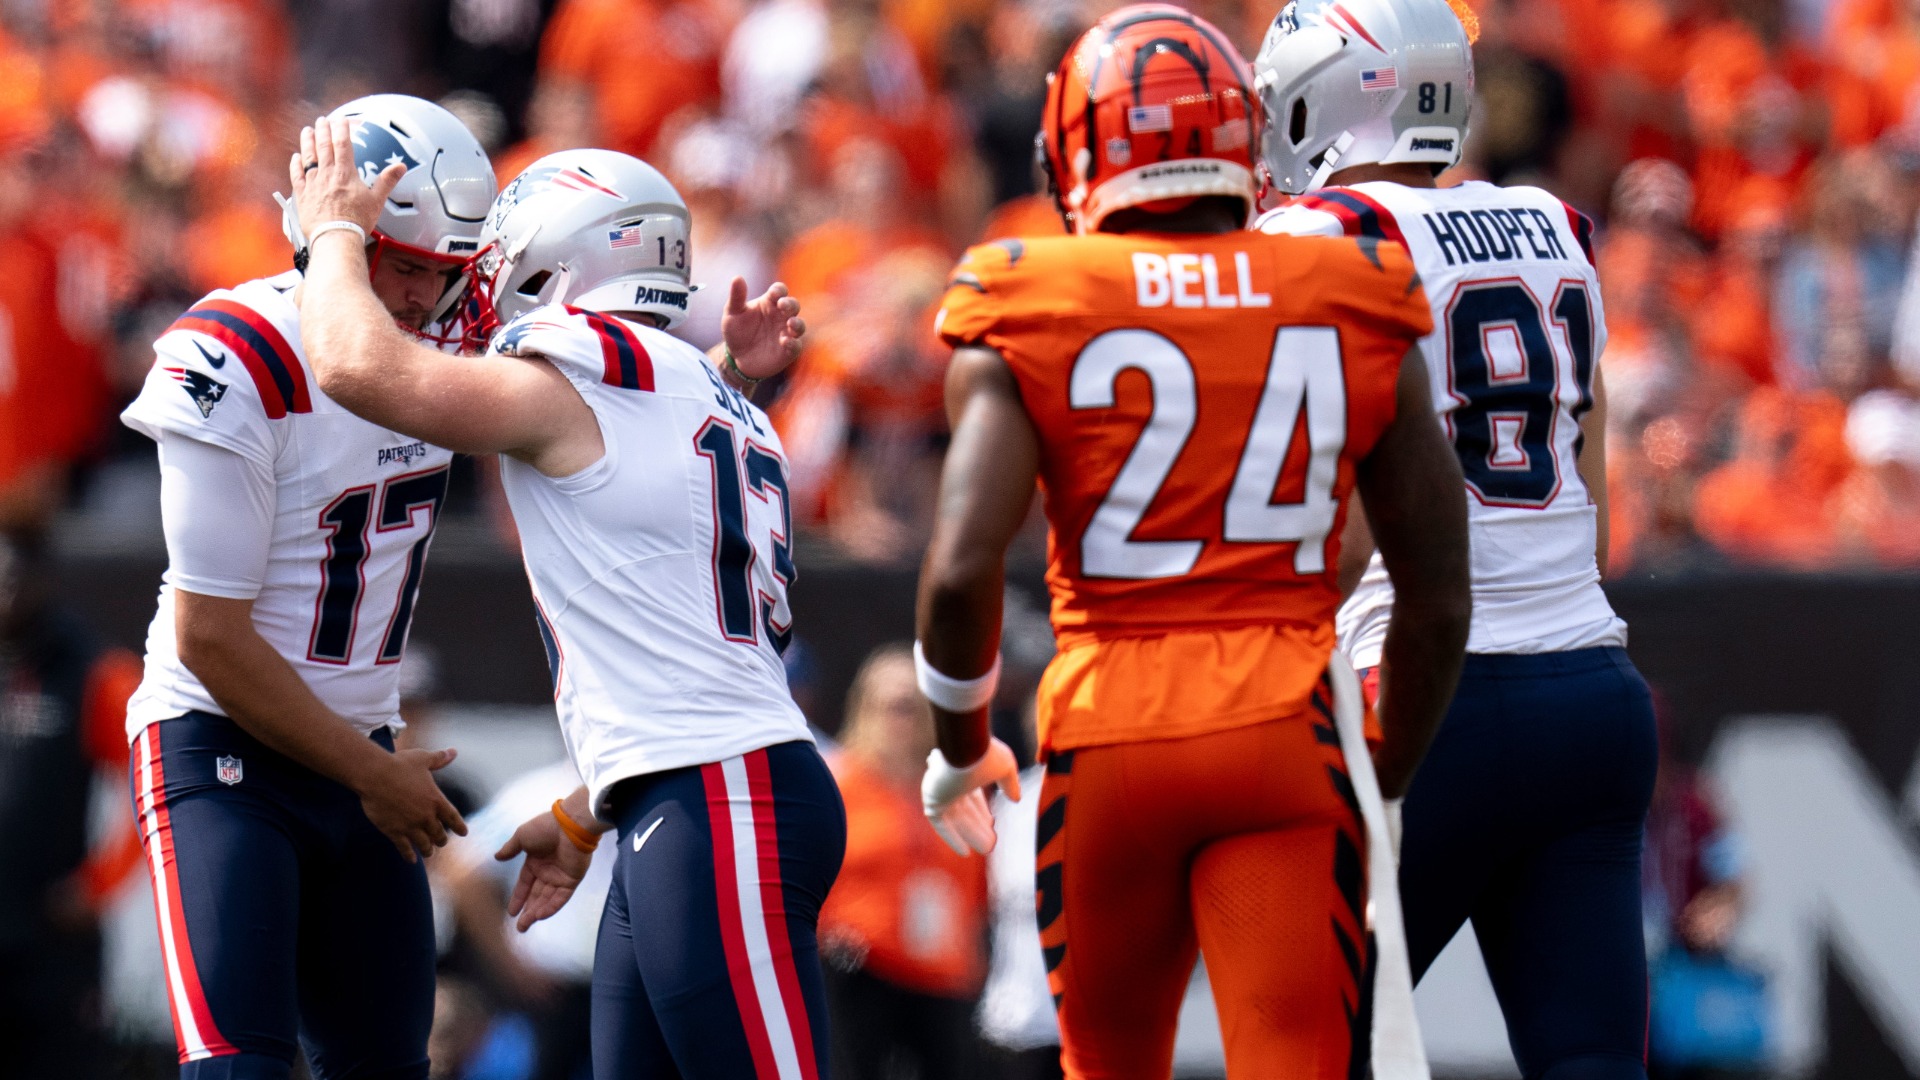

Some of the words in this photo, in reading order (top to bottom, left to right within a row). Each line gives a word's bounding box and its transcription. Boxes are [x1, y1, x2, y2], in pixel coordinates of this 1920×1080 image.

[1418, 81, 1452, 114] 81
[1155, 127, 1203, 162] 24
[657, 236, 685, 270] 13
[1423, 208, 1568, 266] HOOPER
[634, 285, 689, 311] PATRIOTS
[1131, 251, 1272, 308] BELL
[1444, 276, 1596, 510] 81
[378, 442, 427, 466] PATRIOTS
[1070, 325, 1348, 581] 24
[692, 414, 798, 659] 13
[306, 463, 451, 666] 17
[221, 767, 241, 781] NFL
